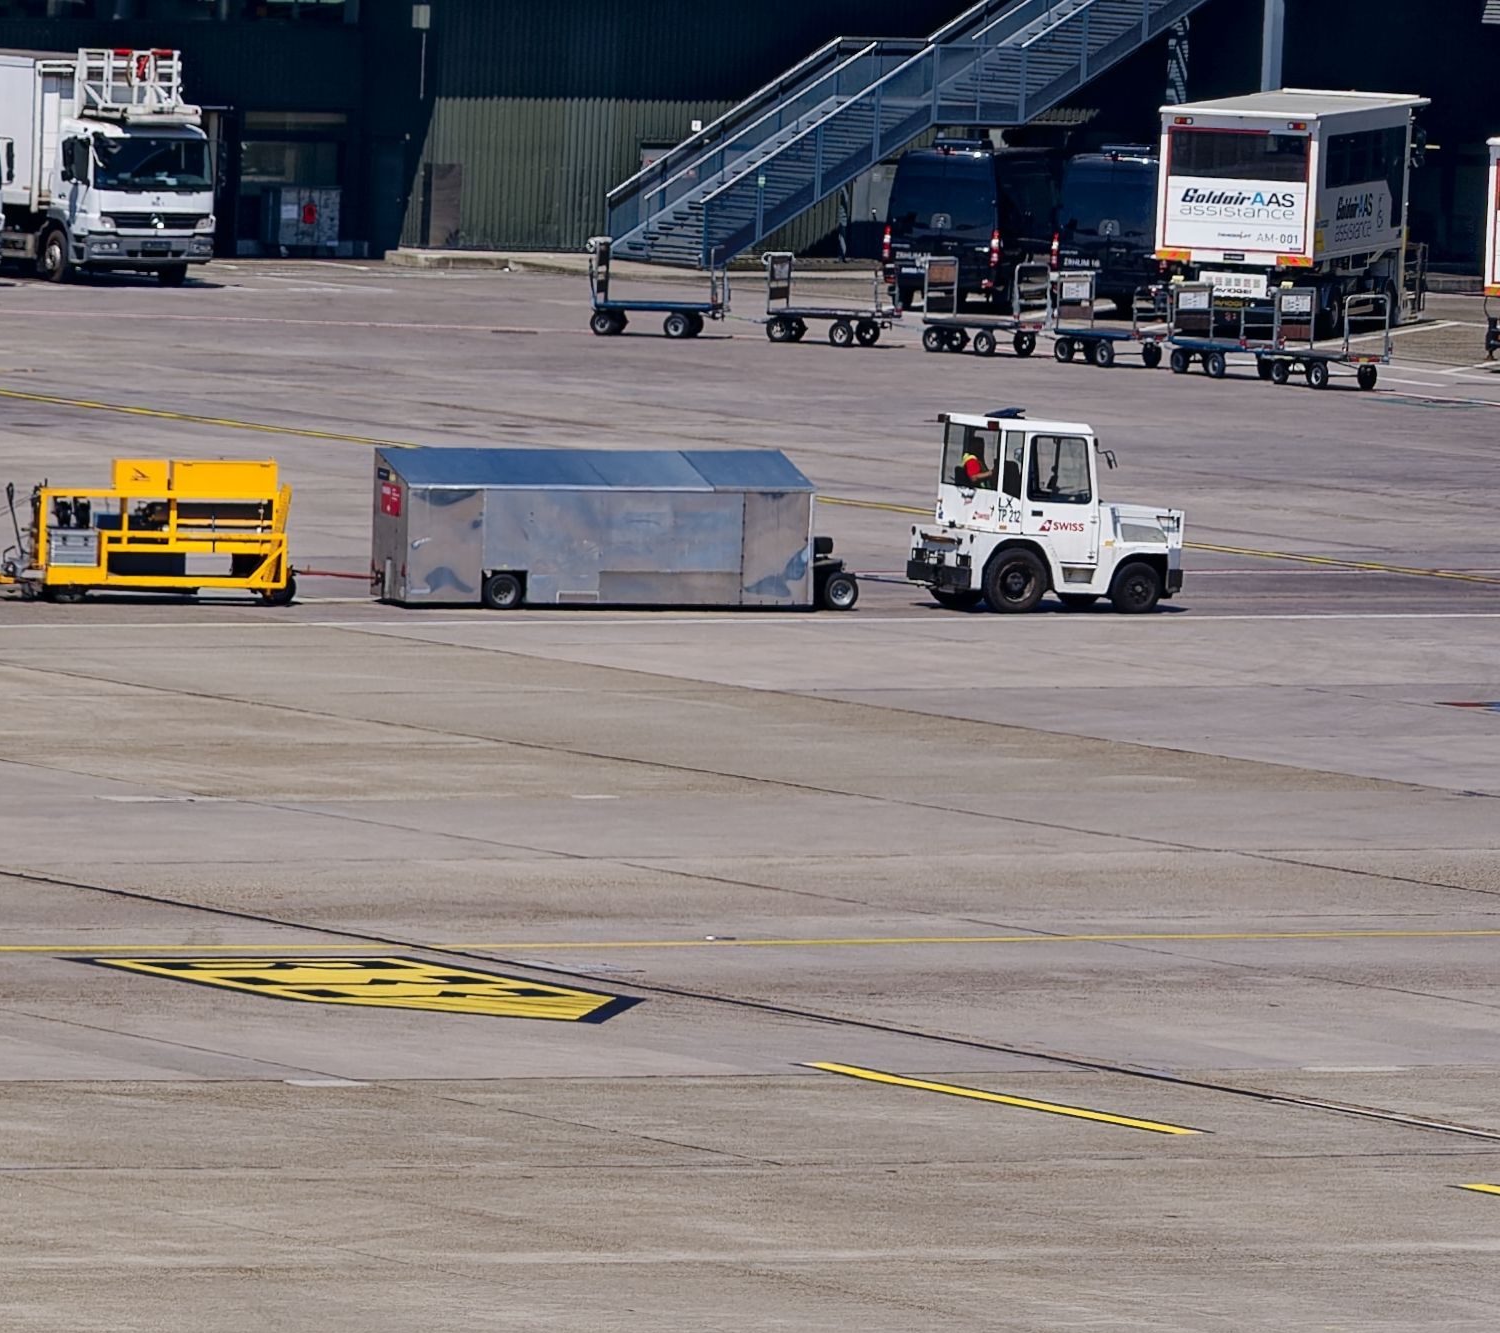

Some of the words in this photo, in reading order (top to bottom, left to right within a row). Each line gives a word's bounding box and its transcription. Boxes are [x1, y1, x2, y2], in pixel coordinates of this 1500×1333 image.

[1179, 205, 1295, 220] assistance
[1256, 233, 1299, 244] AM-001
[998, 498, 1013, 508] LX
[1009, 510, 1020, 522] 212
[1053, 522, 1084, 531] SWISS
